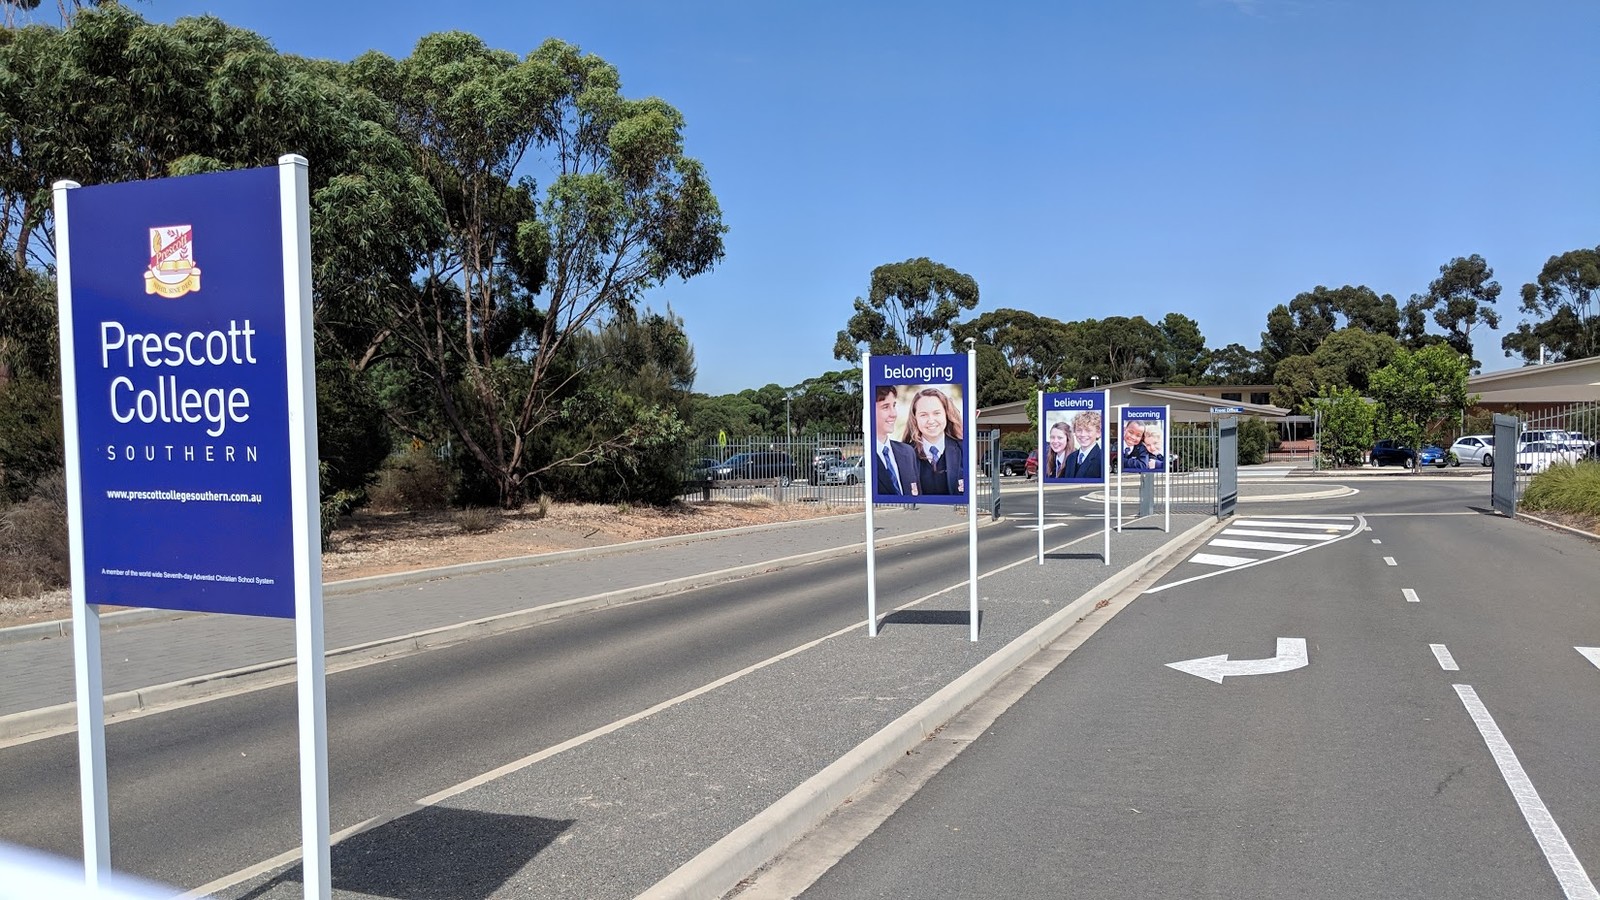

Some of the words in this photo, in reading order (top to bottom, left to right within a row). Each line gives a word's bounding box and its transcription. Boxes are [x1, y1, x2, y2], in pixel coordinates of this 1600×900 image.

[101, 320, 257, 368] Prescott
[884, 364, 953, 381] belonging
[110, 375, 250, 437] College
[1054, 397, 1093, 409] believing
[1127, 410, 1160, 420] becoming
[107, 446, 257, 461] SOUTHERN
[107, 490, 262, 504] www.prescottcollegesouthern.com.au
[164, 571, 192, 581] Seventh-day
[216, 574, 238, 582] Christian
[238, 575, 254, 583] School
[256, 576, 274, 585] System
